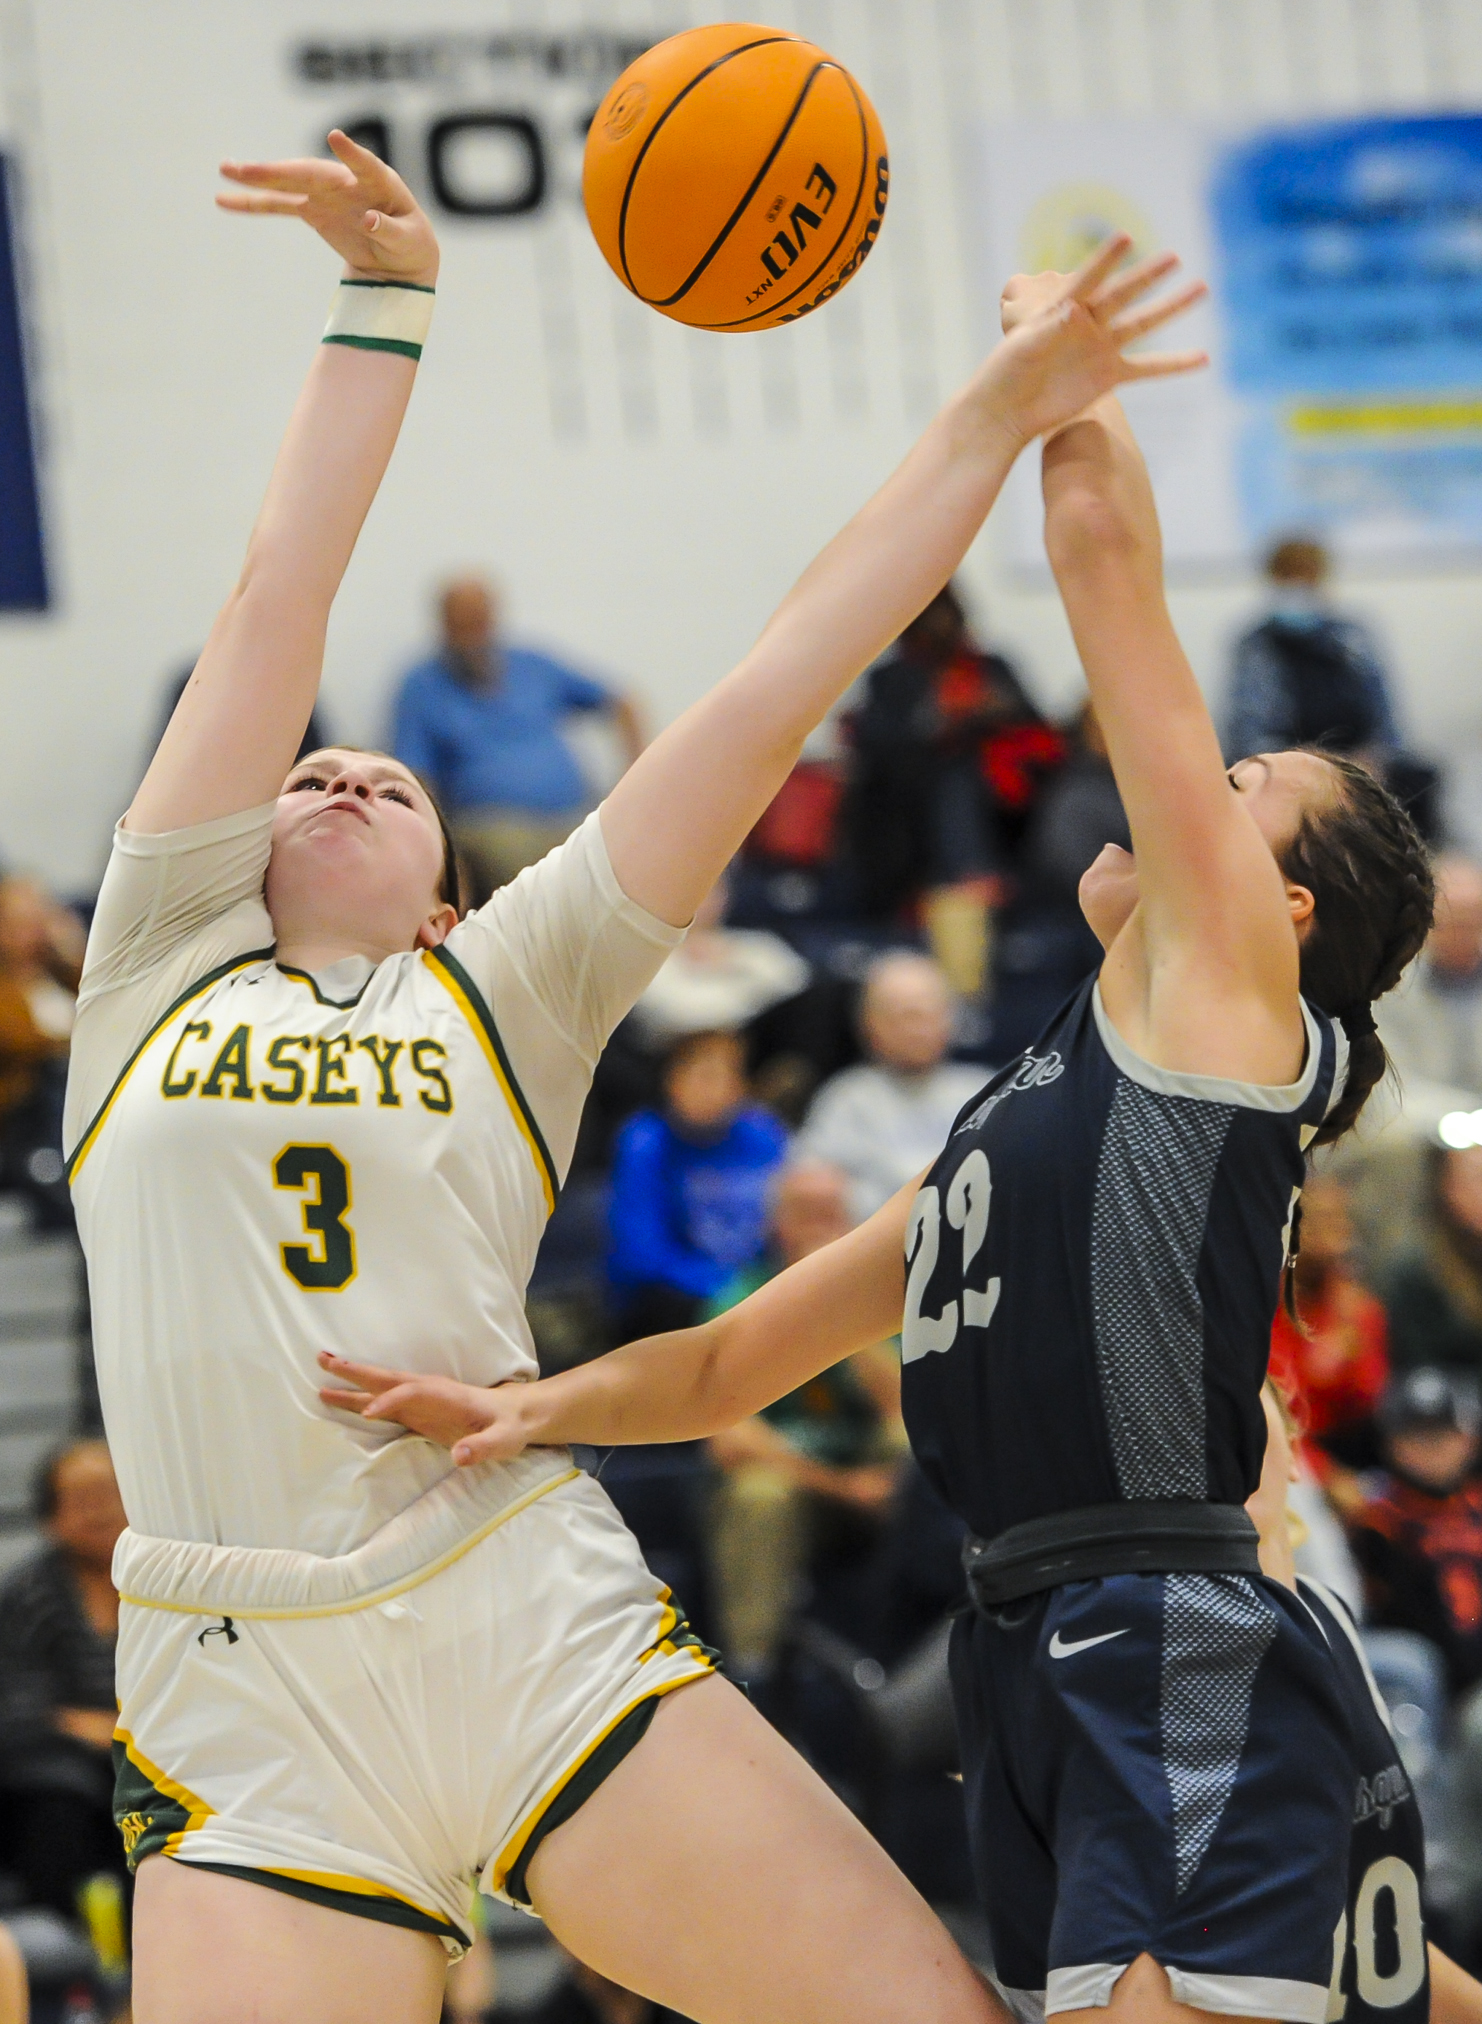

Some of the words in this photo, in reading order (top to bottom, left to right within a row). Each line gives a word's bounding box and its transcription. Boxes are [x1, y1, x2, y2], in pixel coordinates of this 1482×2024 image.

[759, 162, 838, 281] EVO
[745, 277, 774, 306] NXT
[160, 1019, 454, 1117] CASEYS
[271, 1141, 358, 1293] 3
[902, 1148, 1001, 1366] 22
